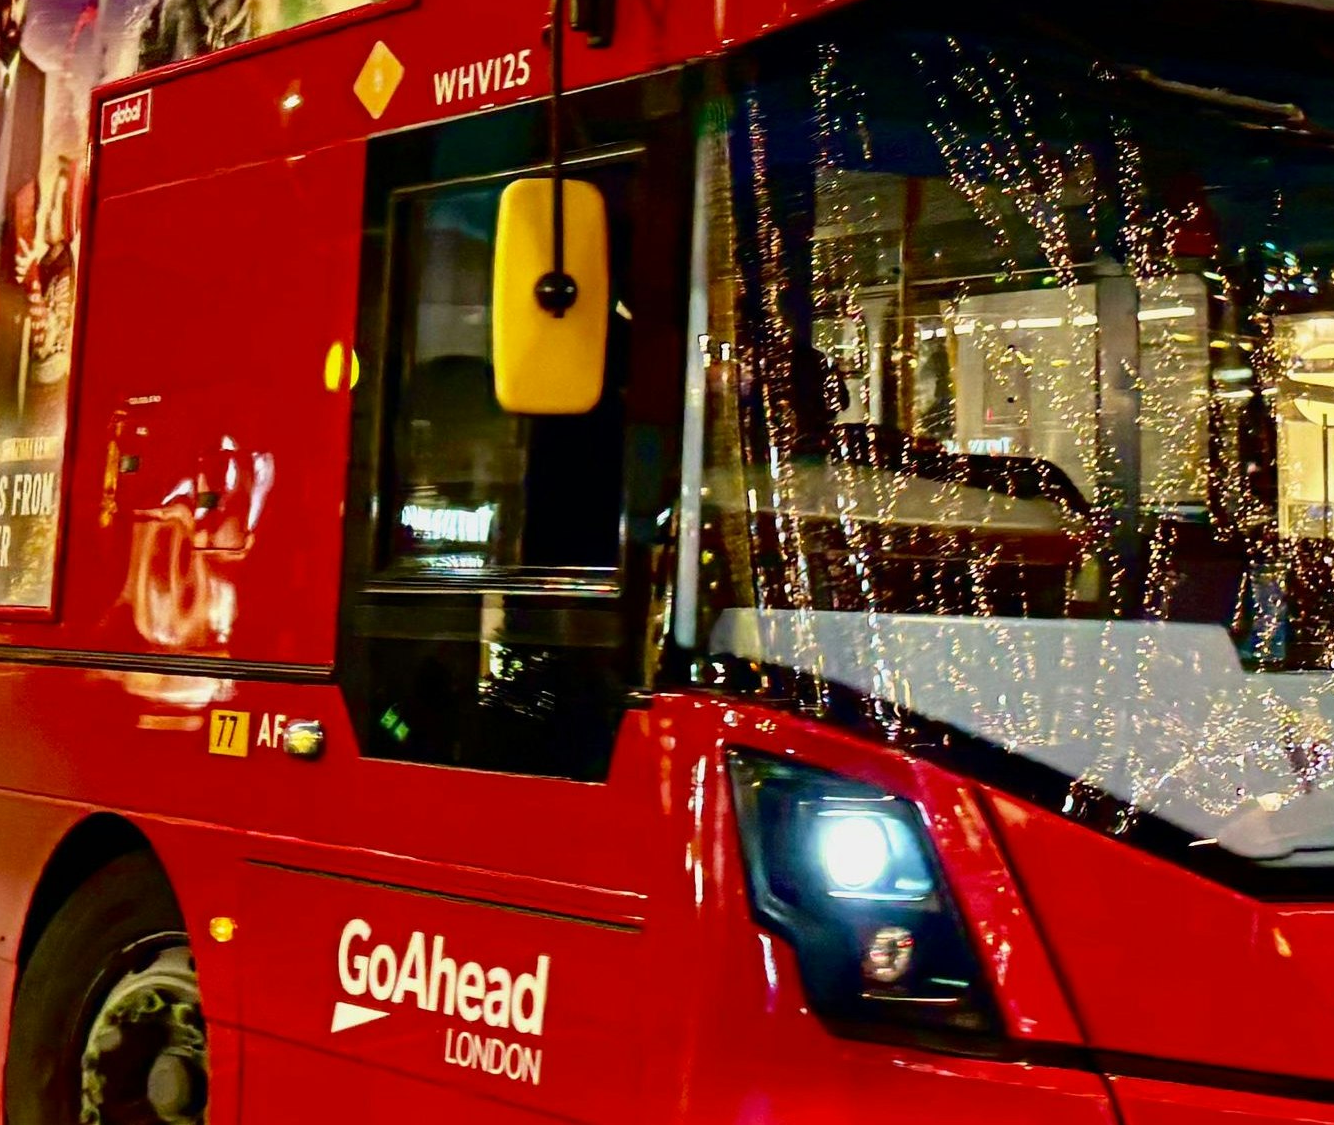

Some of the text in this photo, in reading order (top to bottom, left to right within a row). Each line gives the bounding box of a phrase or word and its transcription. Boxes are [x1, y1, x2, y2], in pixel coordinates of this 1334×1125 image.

[433, 49, 533, 106] WHV125
[10, 472, 55, 516] FROM
[218, 714, 239, 748] 77
[338, 918, 551, 1036] GoAhead
[444, 1027, 543, 1086] LONDON
